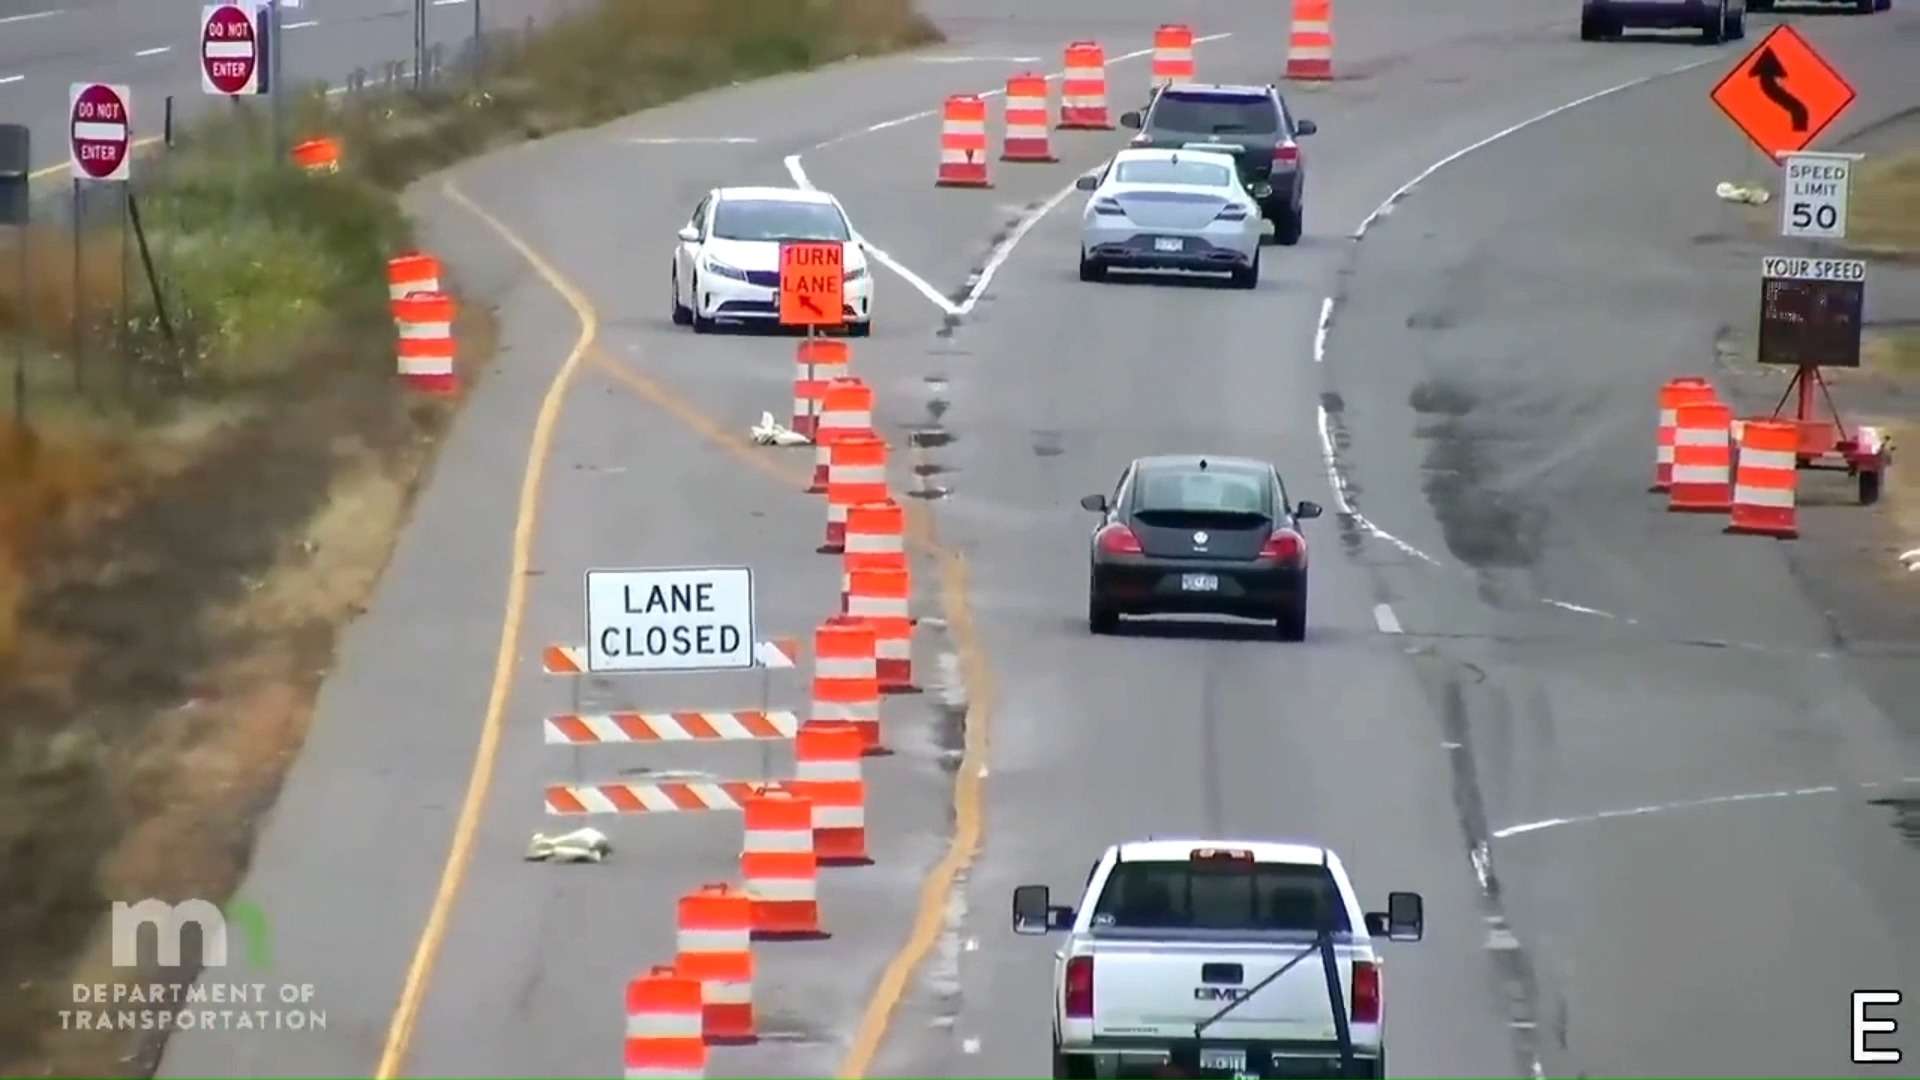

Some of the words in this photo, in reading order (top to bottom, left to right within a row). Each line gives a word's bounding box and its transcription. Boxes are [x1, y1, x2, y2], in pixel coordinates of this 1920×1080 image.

[209, 22, 224, 37] DO
[227, 22, 248, 37] NOT
[213, 62, 246, 77] ENTER
[79, 102, 94, 118] DO
[97, 102, 119, 119] NOT
[82, 145, 116, 160] ENTER
[1790, 165, 1845, 180] SPEED
[1794, 183, 1838, 197] LIMIT
[1792, 203, 1837, 229] 50
[784, 247, 839, 266] TURN
[1765, 259, 1810, 277] YOUR
[1815, 262, 1864, 280] SPEED
[783, 275, 838, 294] LANE
[624, 583, 715, 614] LANE
[601, 625, 740, 657] CLOSED
[1194, 987, 1250, 1001] GMC
